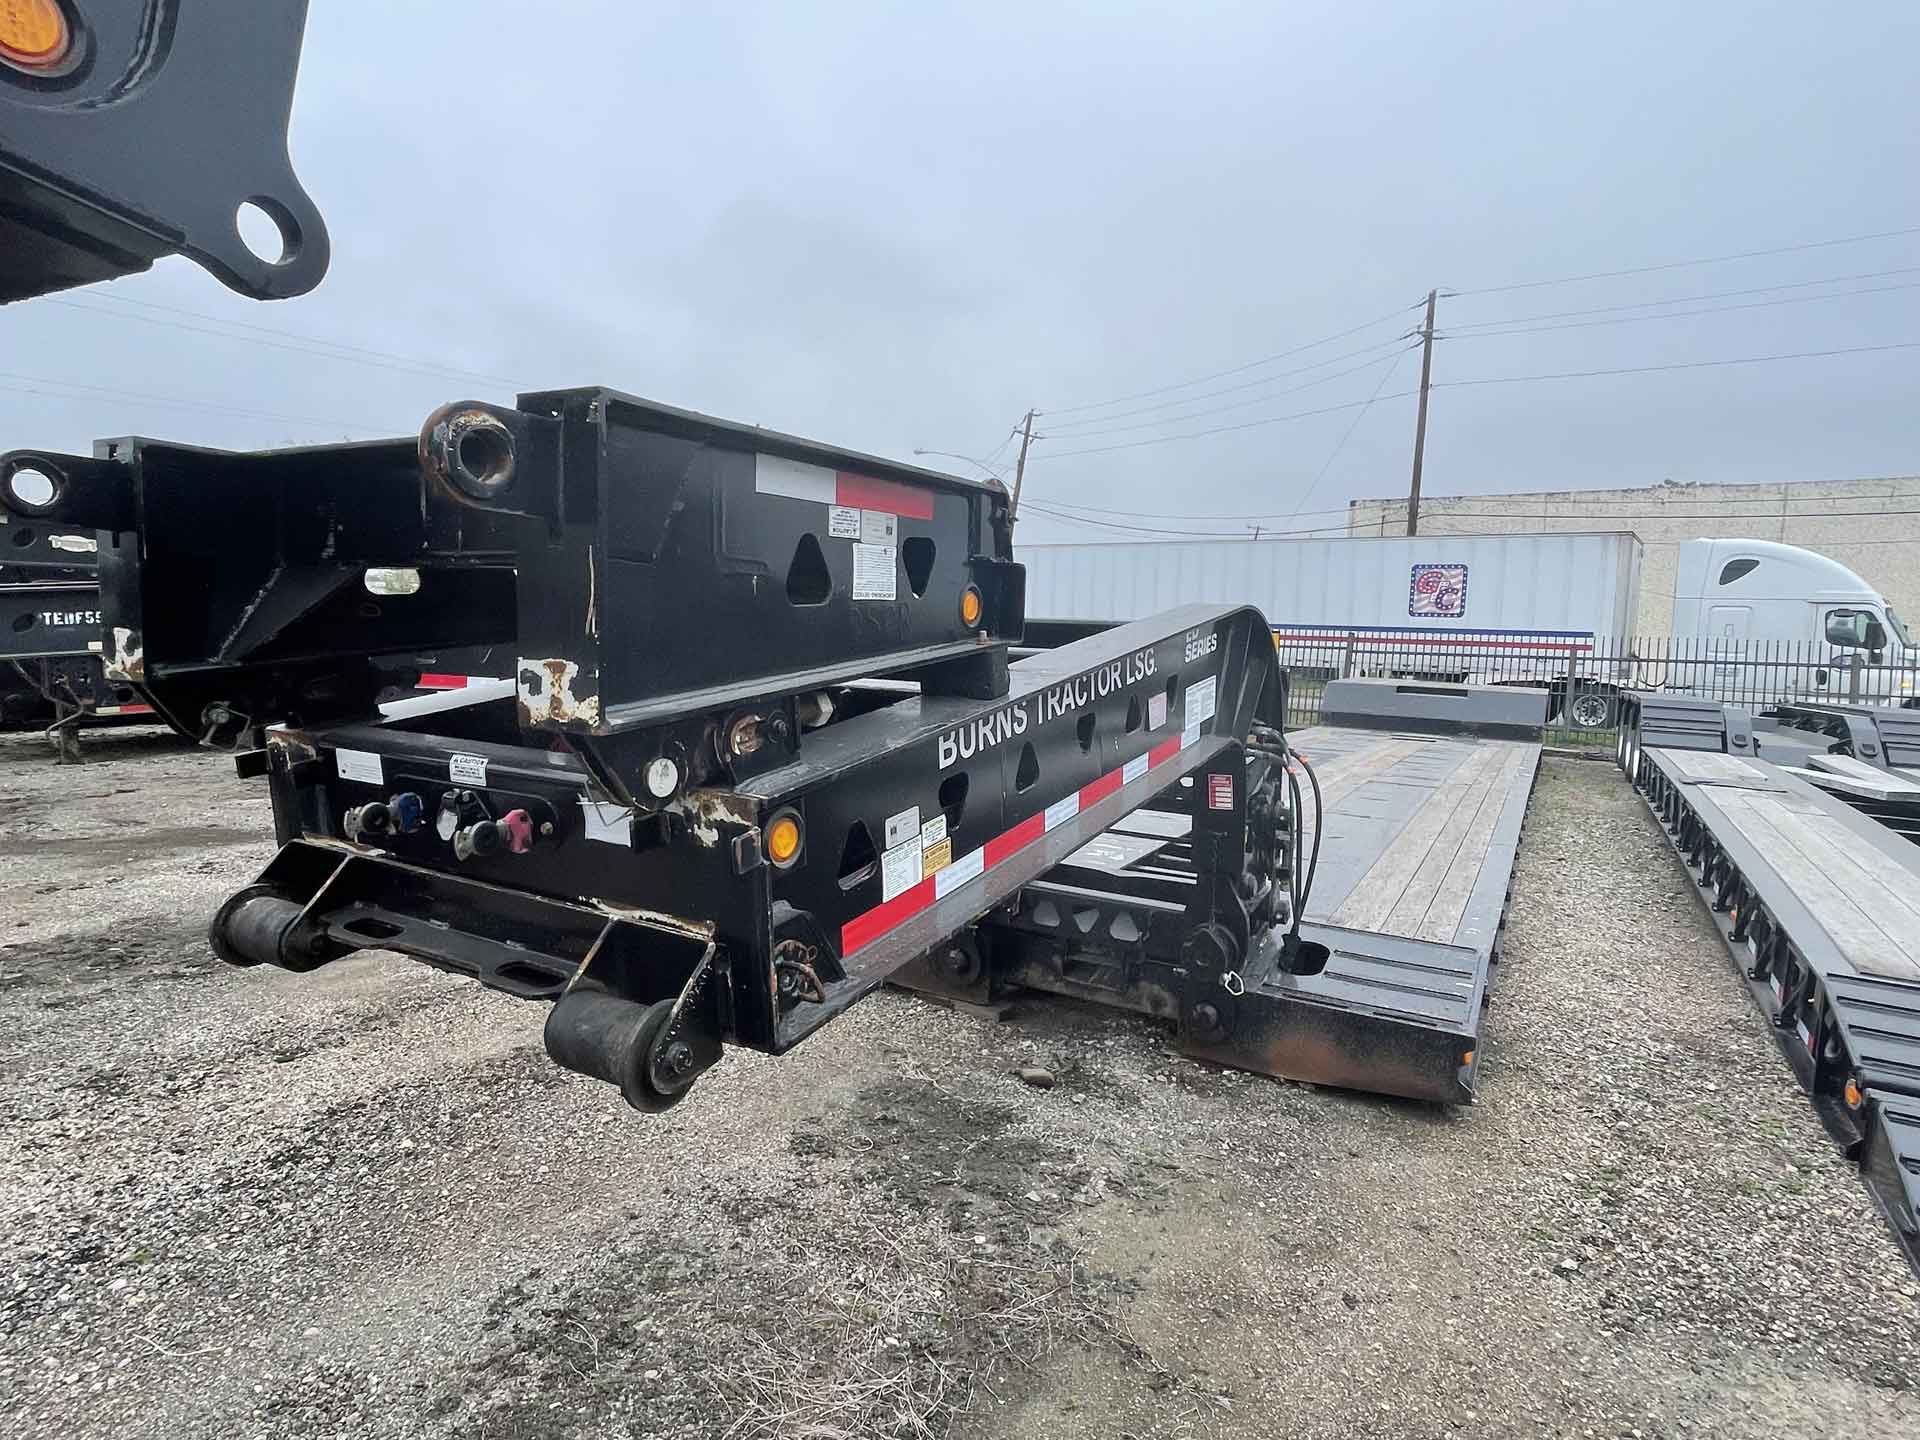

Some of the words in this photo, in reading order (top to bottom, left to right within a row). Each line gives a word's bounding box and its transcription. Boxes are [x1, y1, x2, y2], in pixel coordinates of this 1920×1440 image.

[1184, 633, 1218, 663] SERIES
[938, 702, 1028, 770] BURNS
[1036, 661, 1123, 725] TRACTOR
